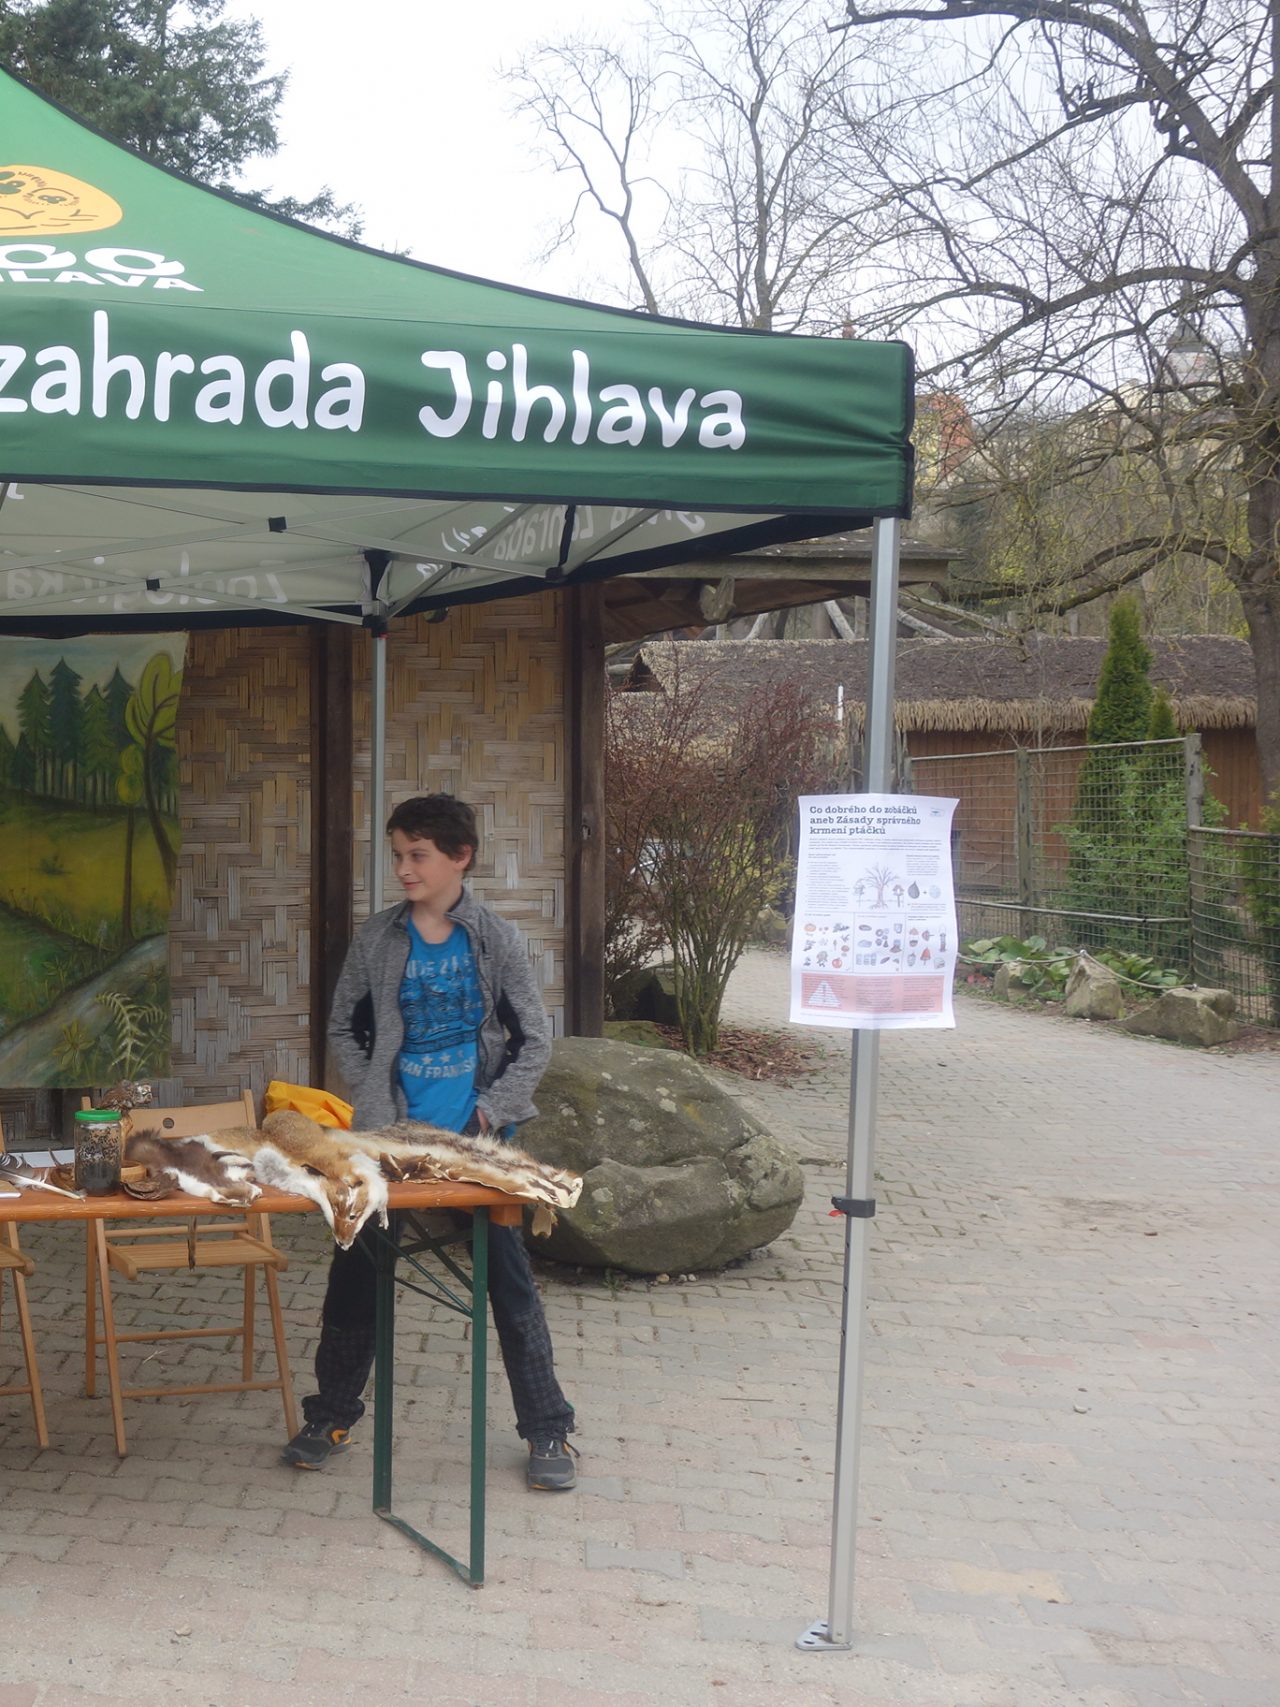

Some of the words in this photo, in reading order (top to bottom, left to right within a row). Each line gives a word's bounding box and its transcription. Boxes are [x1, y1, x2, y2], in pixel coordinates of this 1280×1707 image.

[418, 343, 746, 452] Jihlava
[809, 806, 823, 814] Co
[825, 805, 867, 814] dobrého
[869, 805, 882, 814] do
[809, 816, 834, 824] aneb
[836, 815, 875, 826] Zásady
[876, 816, 921, 826] správného
[809, 826, 847, 835] krmení
